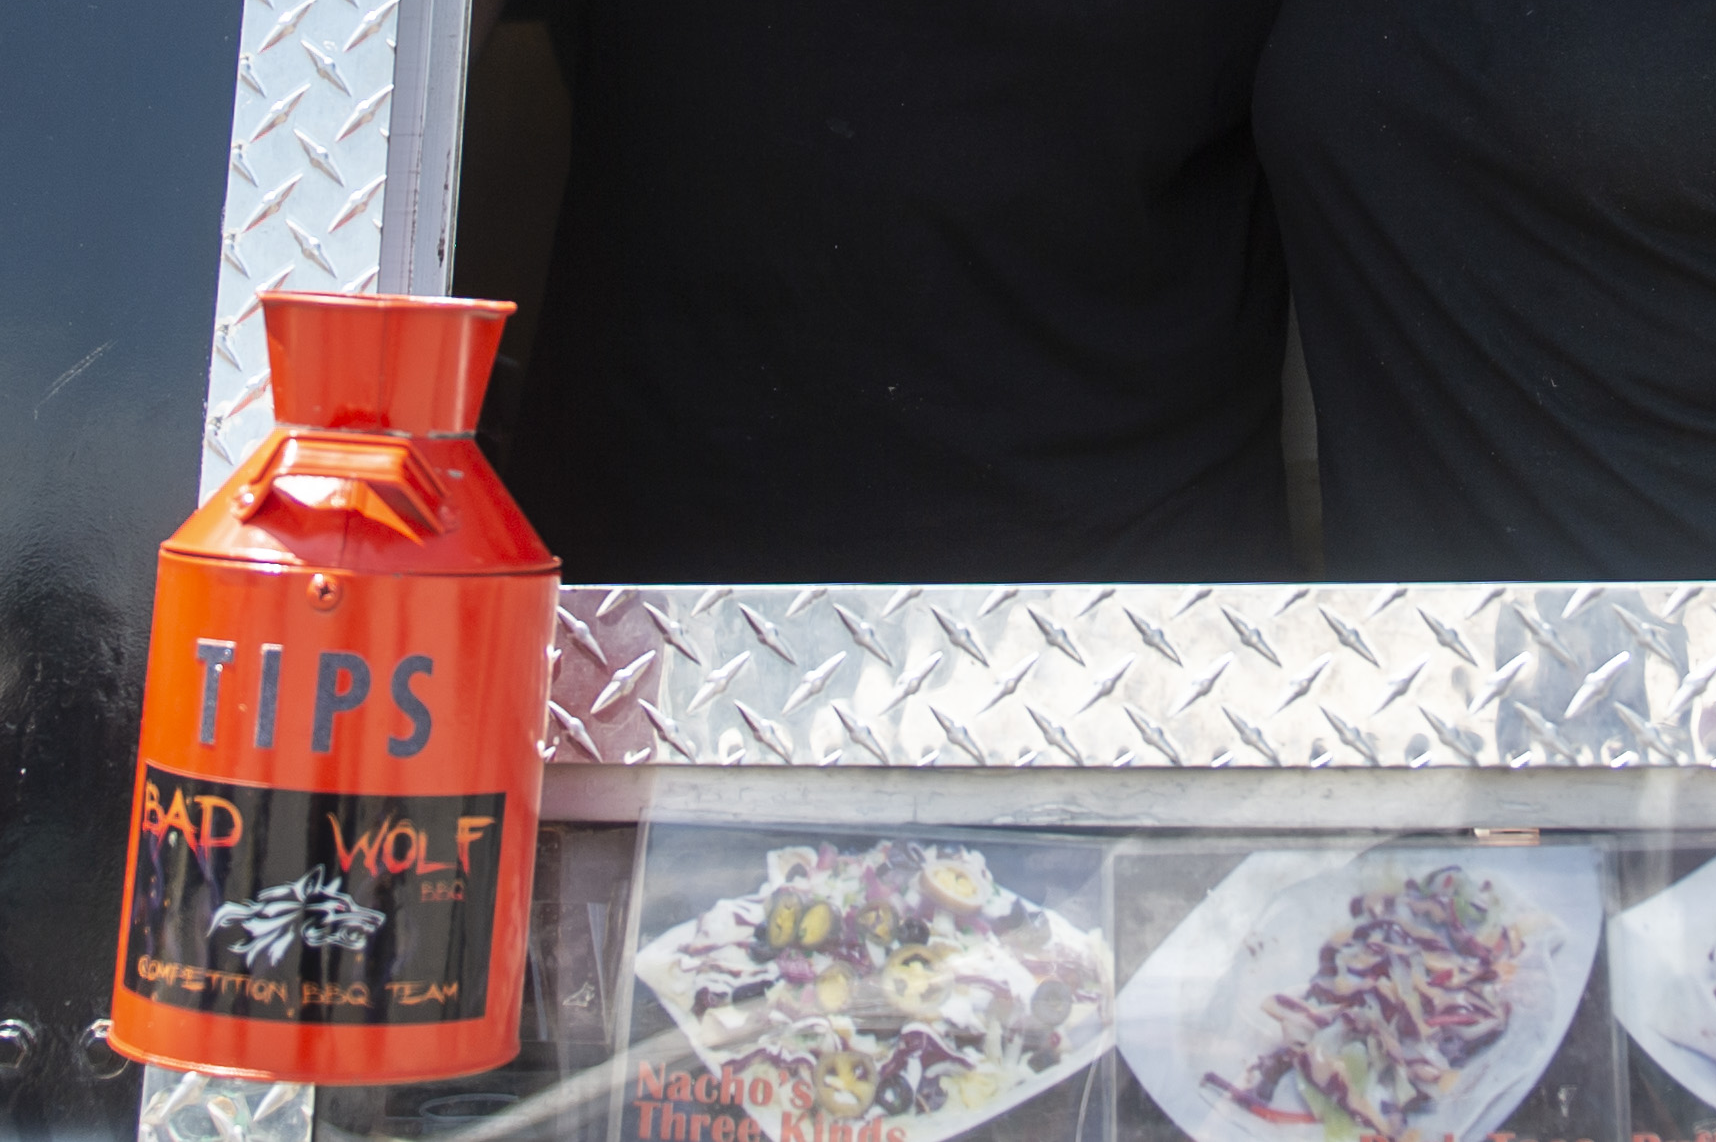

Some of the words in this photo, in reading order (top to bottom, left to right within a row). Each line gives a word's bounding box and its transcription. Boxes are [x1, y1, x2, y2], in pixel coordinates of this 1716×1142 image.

[196, 637, 434, 759] TIPS
[142, 779, 244, 857] BAD
[328, 809, 496, 877] WOLF
[420, 881, 465, 902] BBQ
[137, 954, 287, 1005] COMPETITION
[302, 979, 371, 1007] BBQ
[385, 980, 457, 1006] TEAM
[636, 1060, 814, 1109] Nacho's
[632, 1099, 761, 1142] Three
[780, 1109, 908, 1142] Kinds
